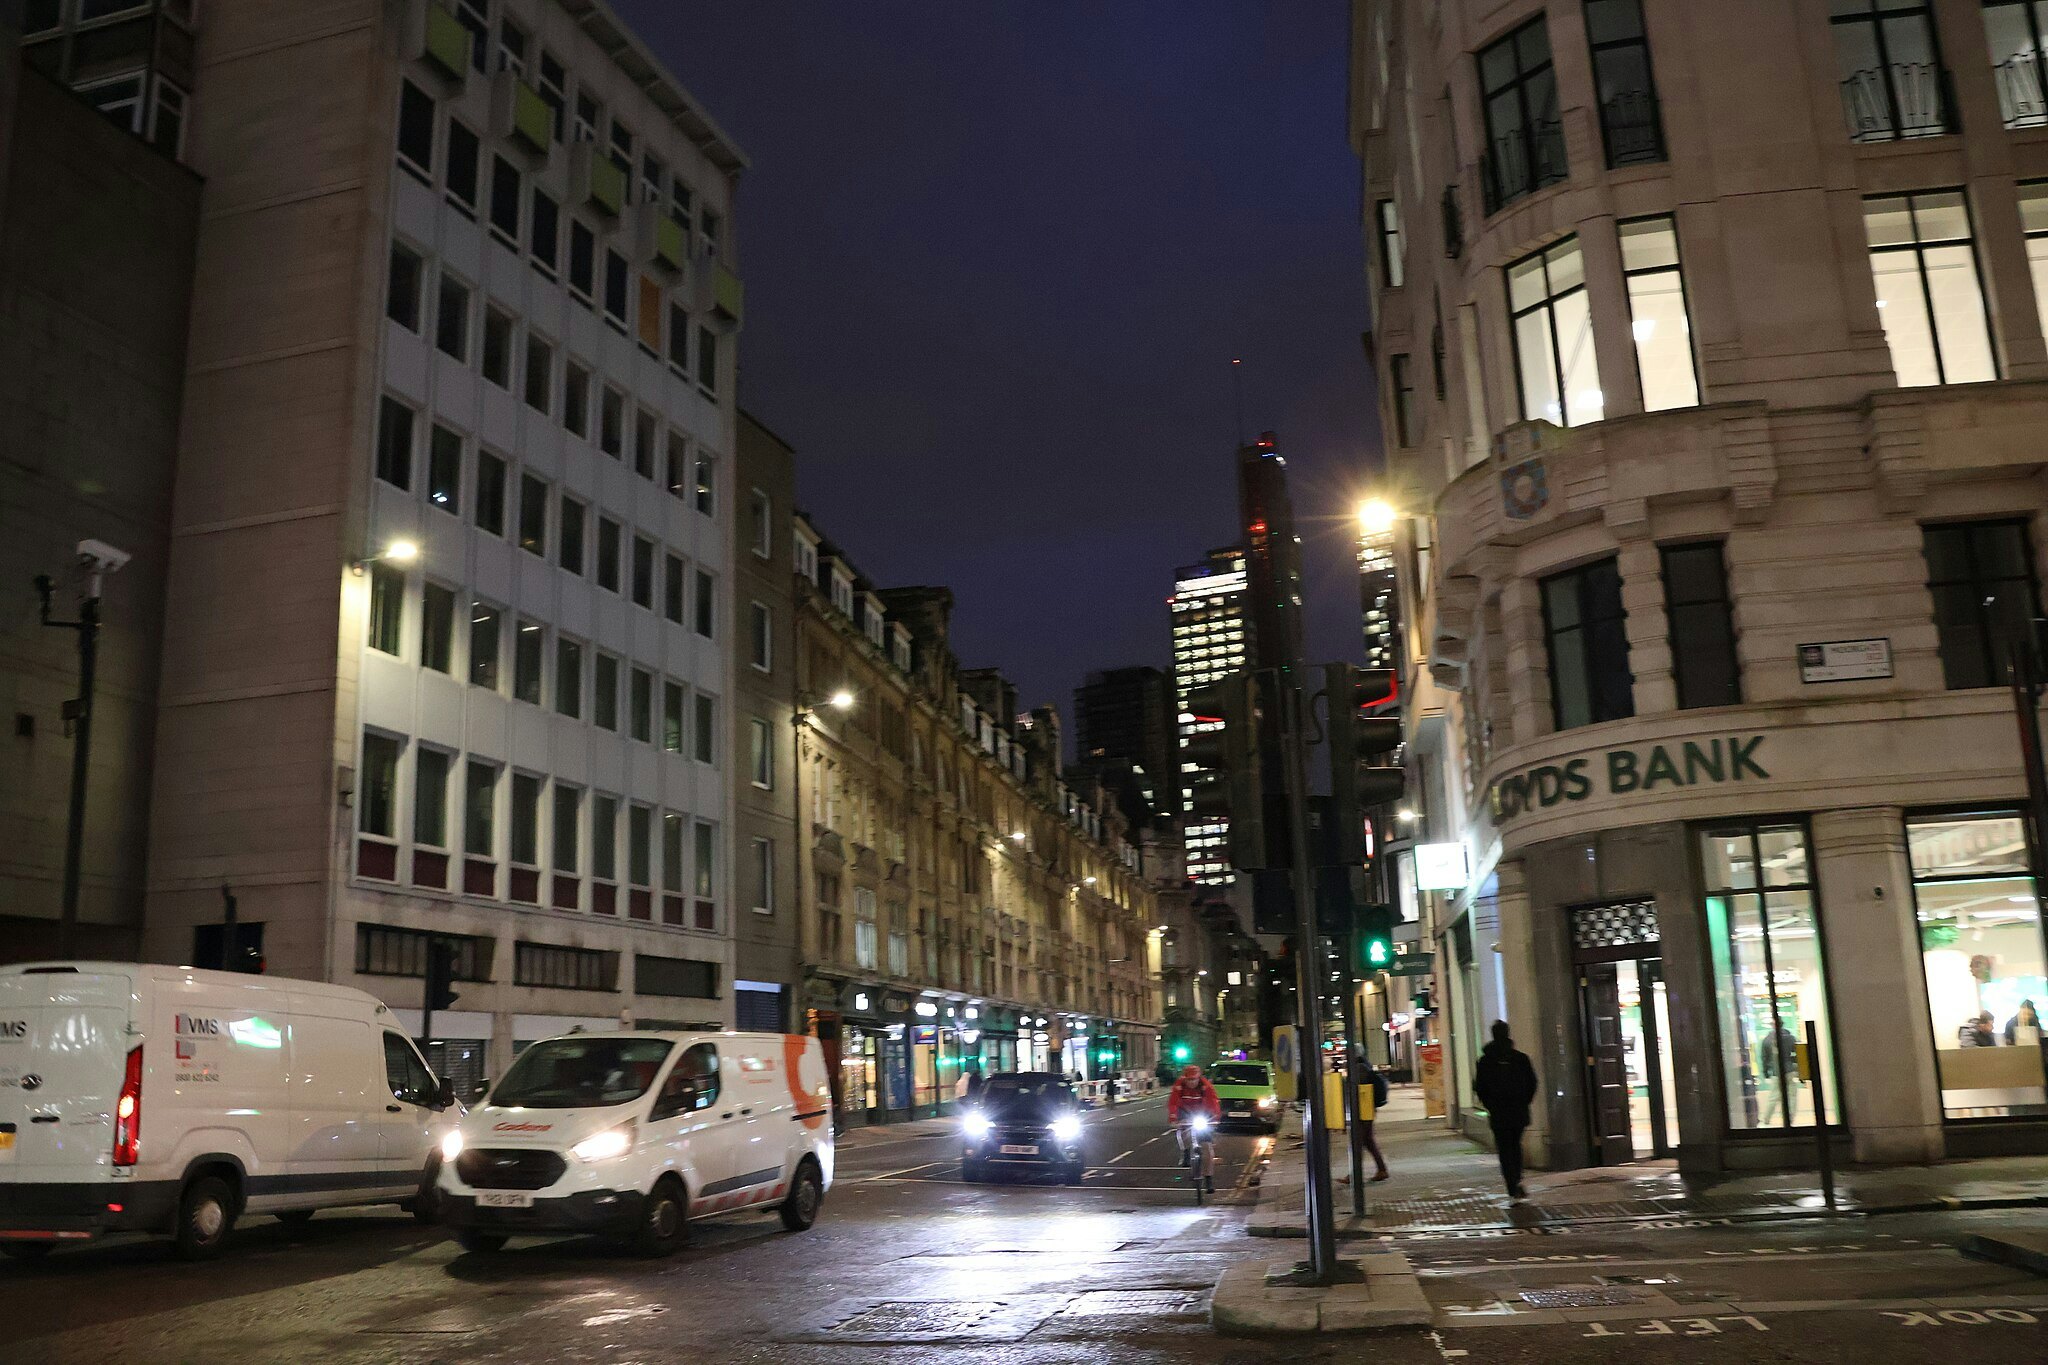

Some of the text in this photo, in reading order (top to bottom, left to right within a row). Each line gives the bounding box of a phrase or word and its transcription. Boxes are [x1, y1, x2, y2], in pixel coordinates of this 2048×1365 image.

[1607, 736, 1770, 794] BANK
[0, 1020, 27, 1037] MS
[189, 1018, 219, 1034] VMS
[1487, 1255, 1621, 1263] LOOK
[1582, 1315, 1770, 1338] LEFT
